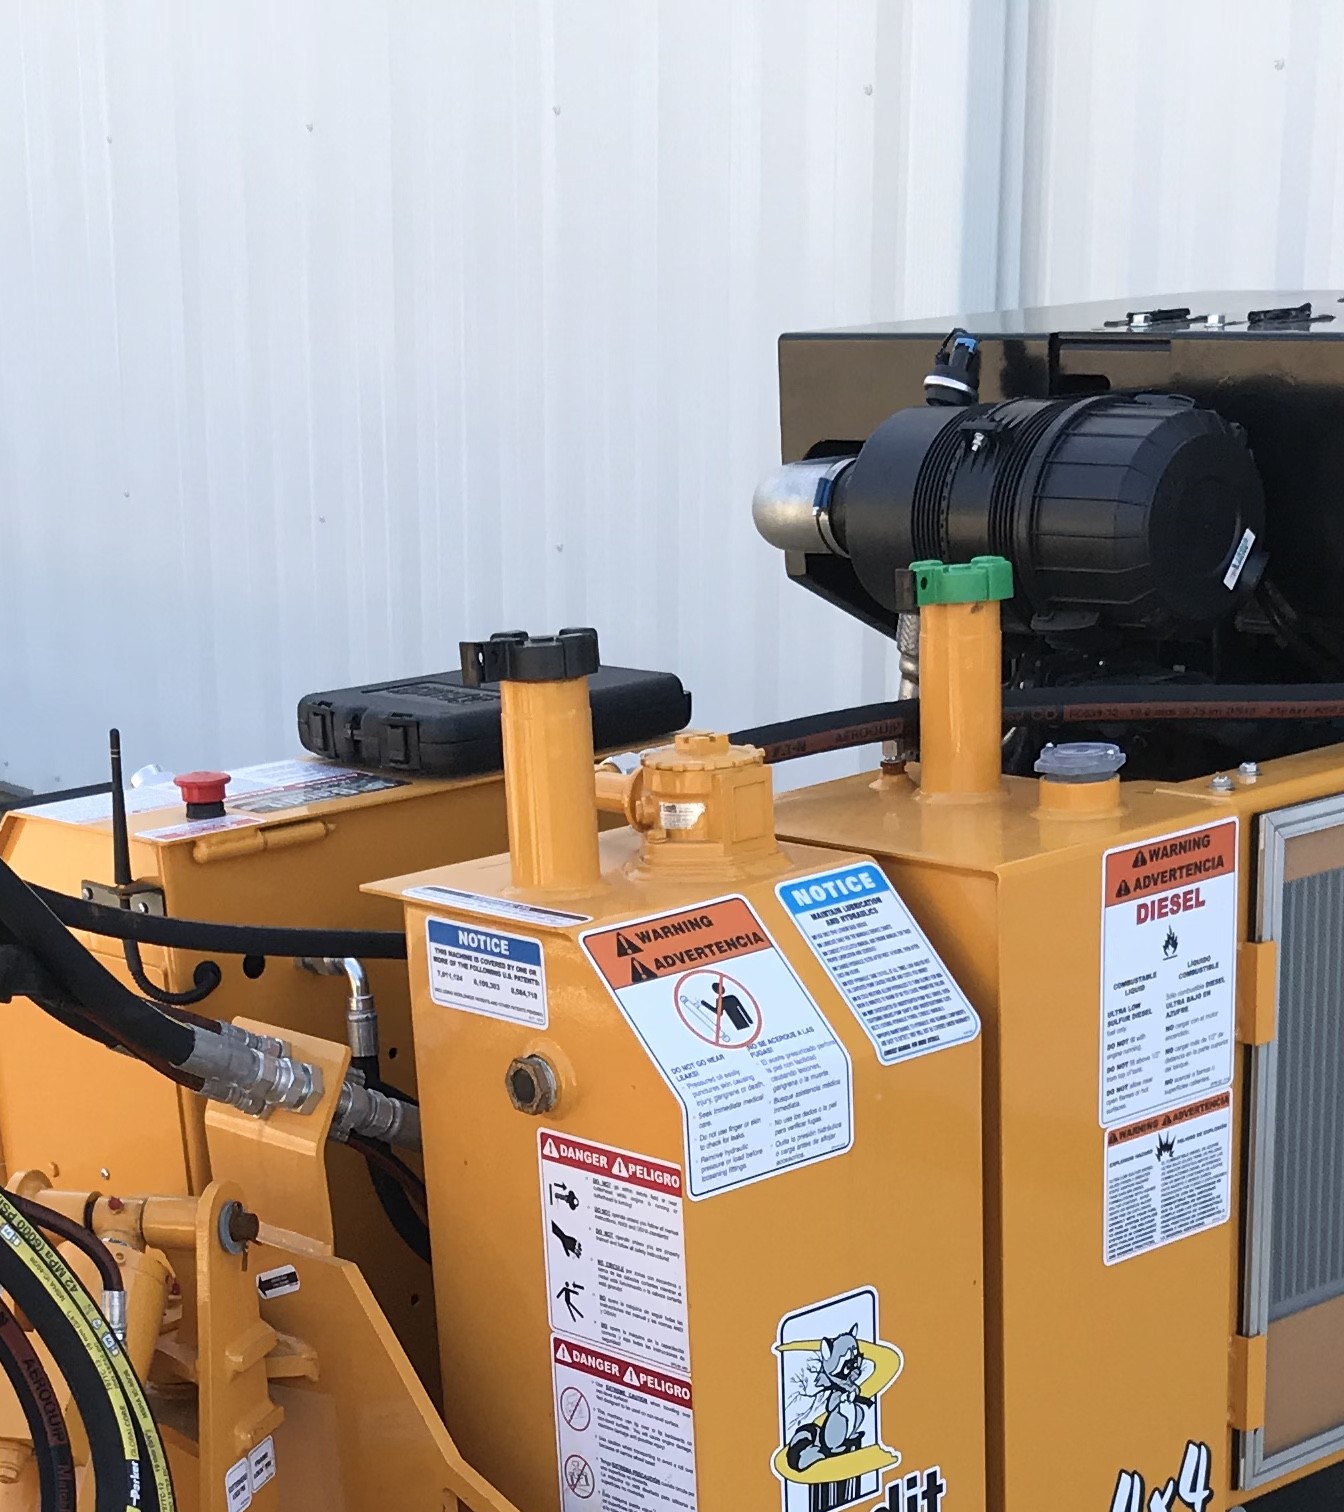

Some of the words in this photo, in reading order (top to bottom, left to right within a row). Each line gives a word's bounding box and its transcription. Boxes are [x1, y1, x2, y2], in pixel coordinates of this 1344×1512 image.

[1148, 834, 1211, 863] WARNING
[791, 872, 876, 906] NOTICE
[1133, 855, 1225, 893] ADVERTENCIA
[1136, 887, 1206, 925] DIESEL
[458, 930, 510, 955] NOTICE
[635, 915, 714, 944] WARNING
[654, 932, 765, 971] ADVERTENCIA
[1119, 1120, 1159, 1139] WARNING
[559, 1144, 609, 1169] DANGER
[628, 1162, 680, 1189] PELIGRO
[13, 1217, 47, 1254] (6000
[41, 1249, 69, 1279] MPa
[62, 1275, 81, 1296] 42
[571, 1349, 620, 1377] DANGER
[639, 1373, 691, 1400] PELIGRO
[23, 1355, 66, 1445] AEROQUIP
[129, 1461, 141, 1505] Parker
